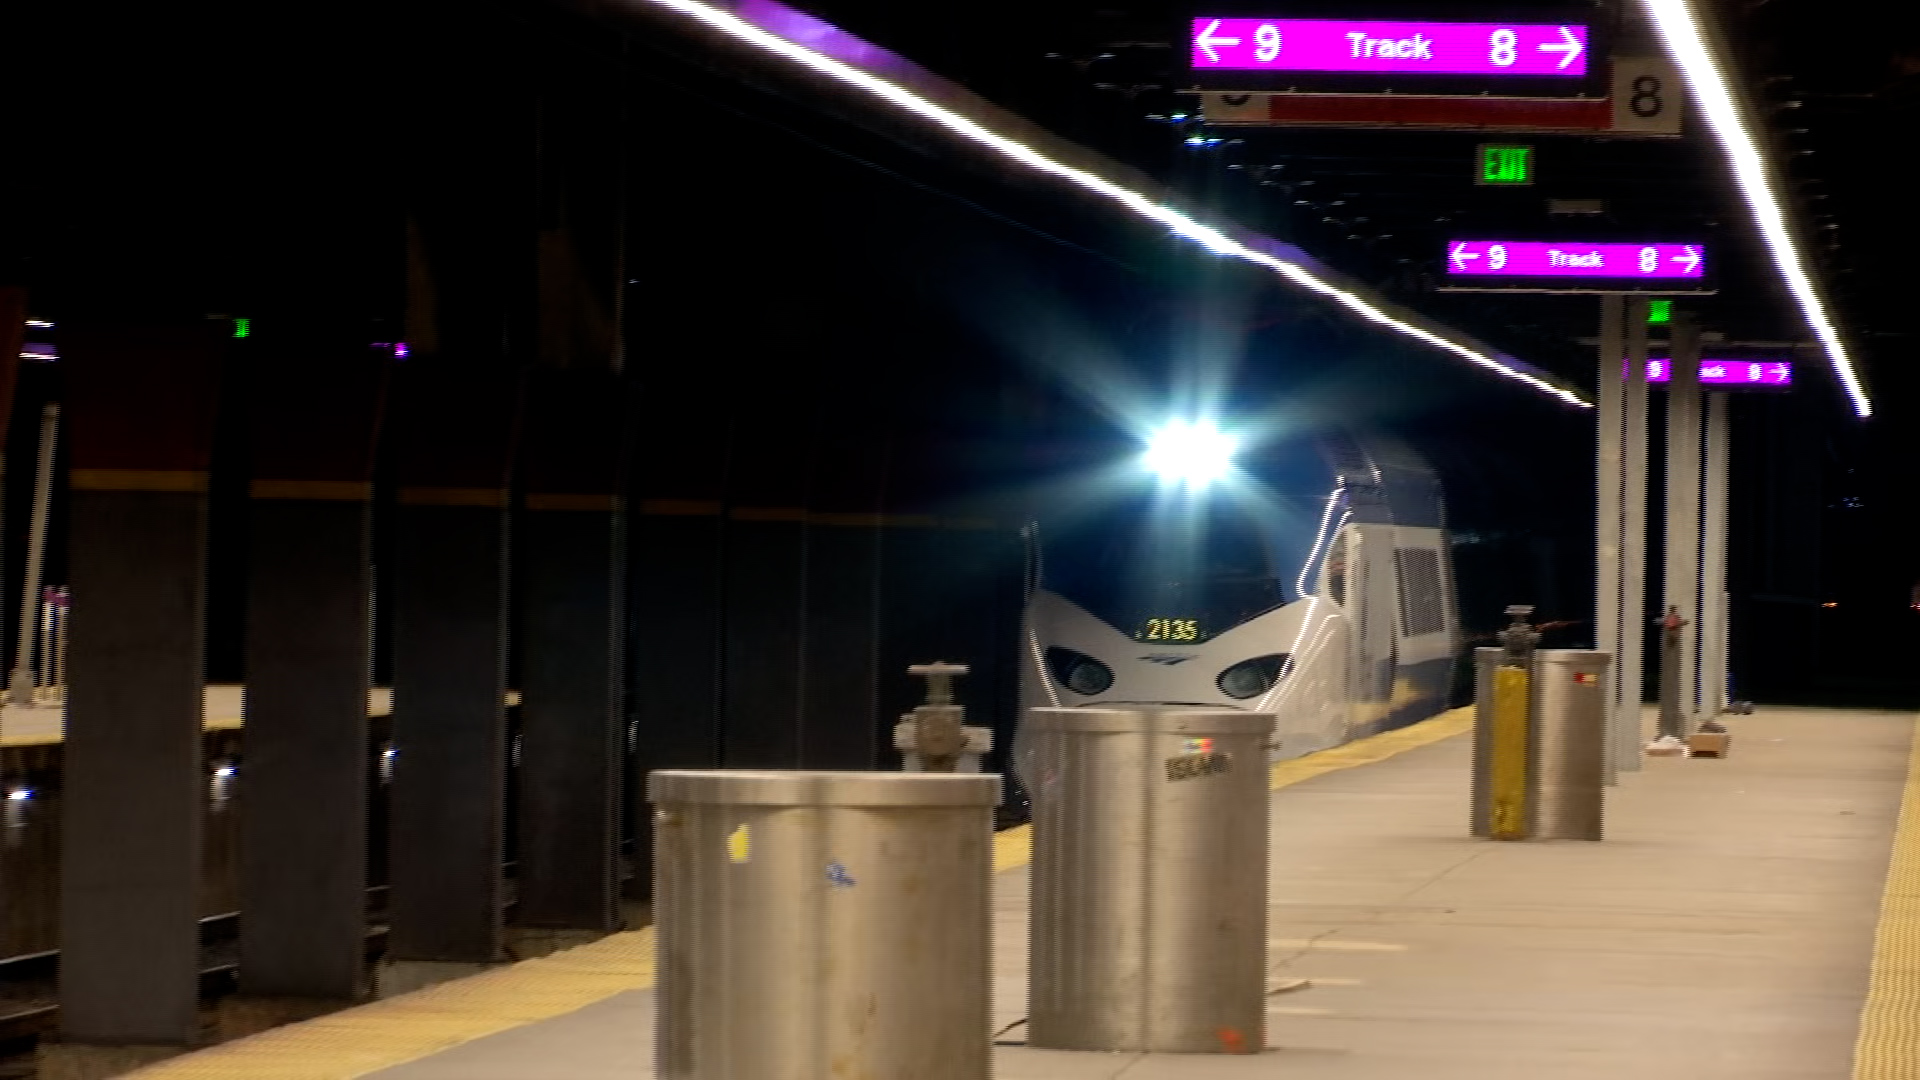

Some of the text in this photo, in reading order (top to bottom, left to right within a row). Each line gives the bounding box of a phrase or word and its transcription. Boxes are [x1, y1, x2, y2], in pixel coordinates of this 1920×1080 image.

[1253, 23, 1518, 67] 9 Track 8
[1629, 75, 1663, 118] 8
[1482, 148, 1530, 183] EXIT
[1487, 244, 1659, 273] 9 Track 8
[1647, 360, 1664, 378] 9
[1747, 362, 1763, 382] 8
[1147, 618, 1198, 641] 2135
